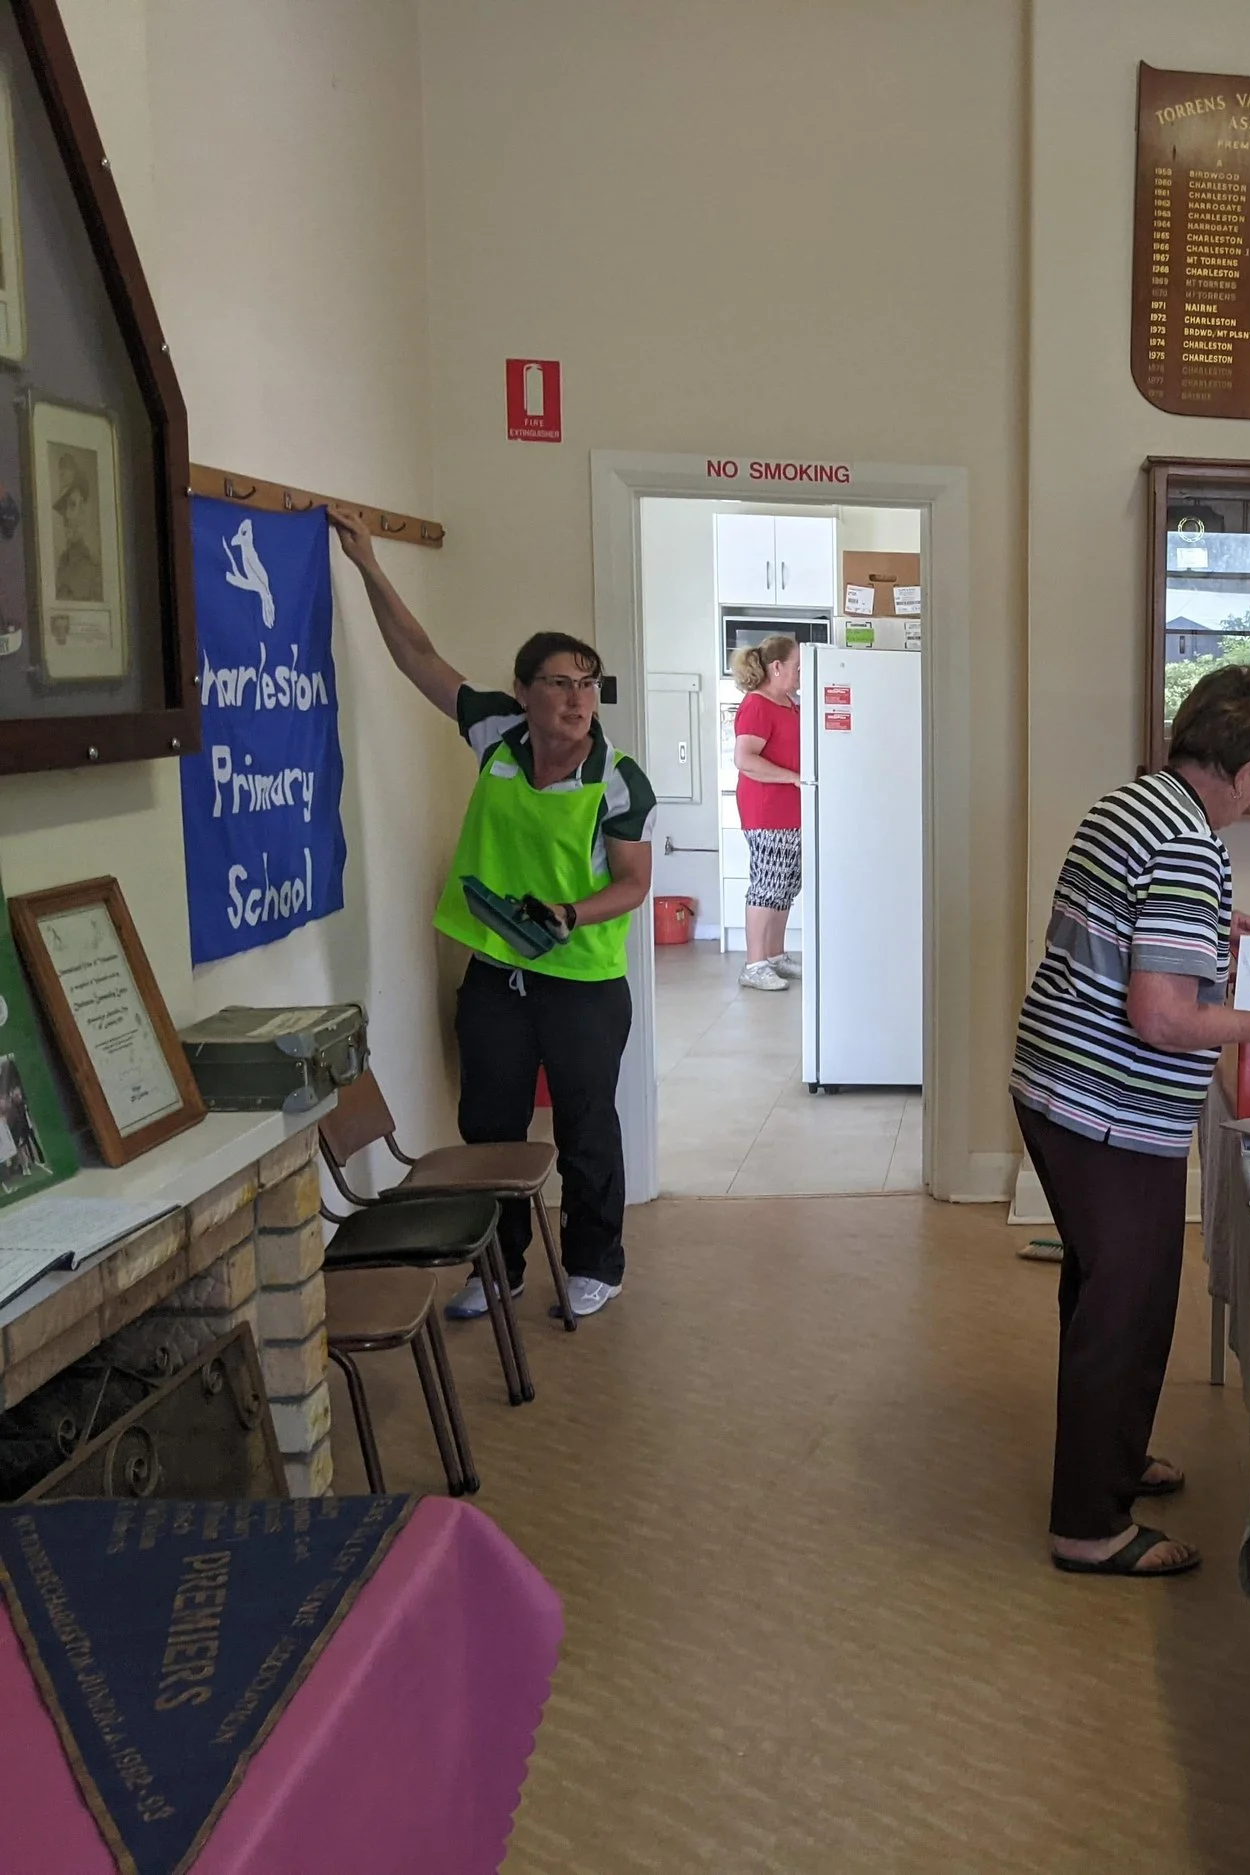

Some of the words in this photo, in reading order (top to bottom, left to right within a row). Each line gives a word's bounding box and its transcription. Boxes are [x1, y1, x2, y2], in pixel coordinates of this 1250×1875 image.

[1155, 95, 1226, 125] TORRENS
[1189, 170, 1240, 181] BIRDWOOD
[1188, 181, 1247, 192] CHARLESTON
[1188, 191, 1246, 202] CHARLESTON
[1188, 202, 1242, 212] HARROGATE
[1187, 212, 1245, 223] CHARLESTON
[1187, 222, 1239, 233] HARROGATE
[1186, 233, 1243, 245] CHARLESTON
[1186, 245, 1242, 256] CHARLESTON
[1152, 253, 1170, 262] 1967
[1186, 256, 1198, 265] MT
[1200, 256, 1239, 267] TORRENS
[1185, 267, 1240, 279] CHARLESTON
[1151, 301, 1166, 310] 1971
[1184, 303, 1218, 313] NAIRNE
[1150, 313, 1167, 322] 1972
[1184, 315, 1237, 327] CHARLESTON
[1150, 325, 1166, 334] 1973
[1149, 338, 1166, 347] 1974
[1183, 340, 1233, 351] CHARLESTON
[1148, 350, 1166, 360] 1975
[1182, 353, 1233, 364] CHARLESTON
[524, 418, 544, 427] FIRE
[509, 428, 560, 438] EXTINGUISHER
[707, 460, 738, 478] NO
[749, 461, 850, 483] SMOKING
[201, 641, 329, 712] harleston
[212, 745, 315, 823] Primary
[227, 847, 313, 929] School
[154, 1550, 231, 1711] PREMIERS
